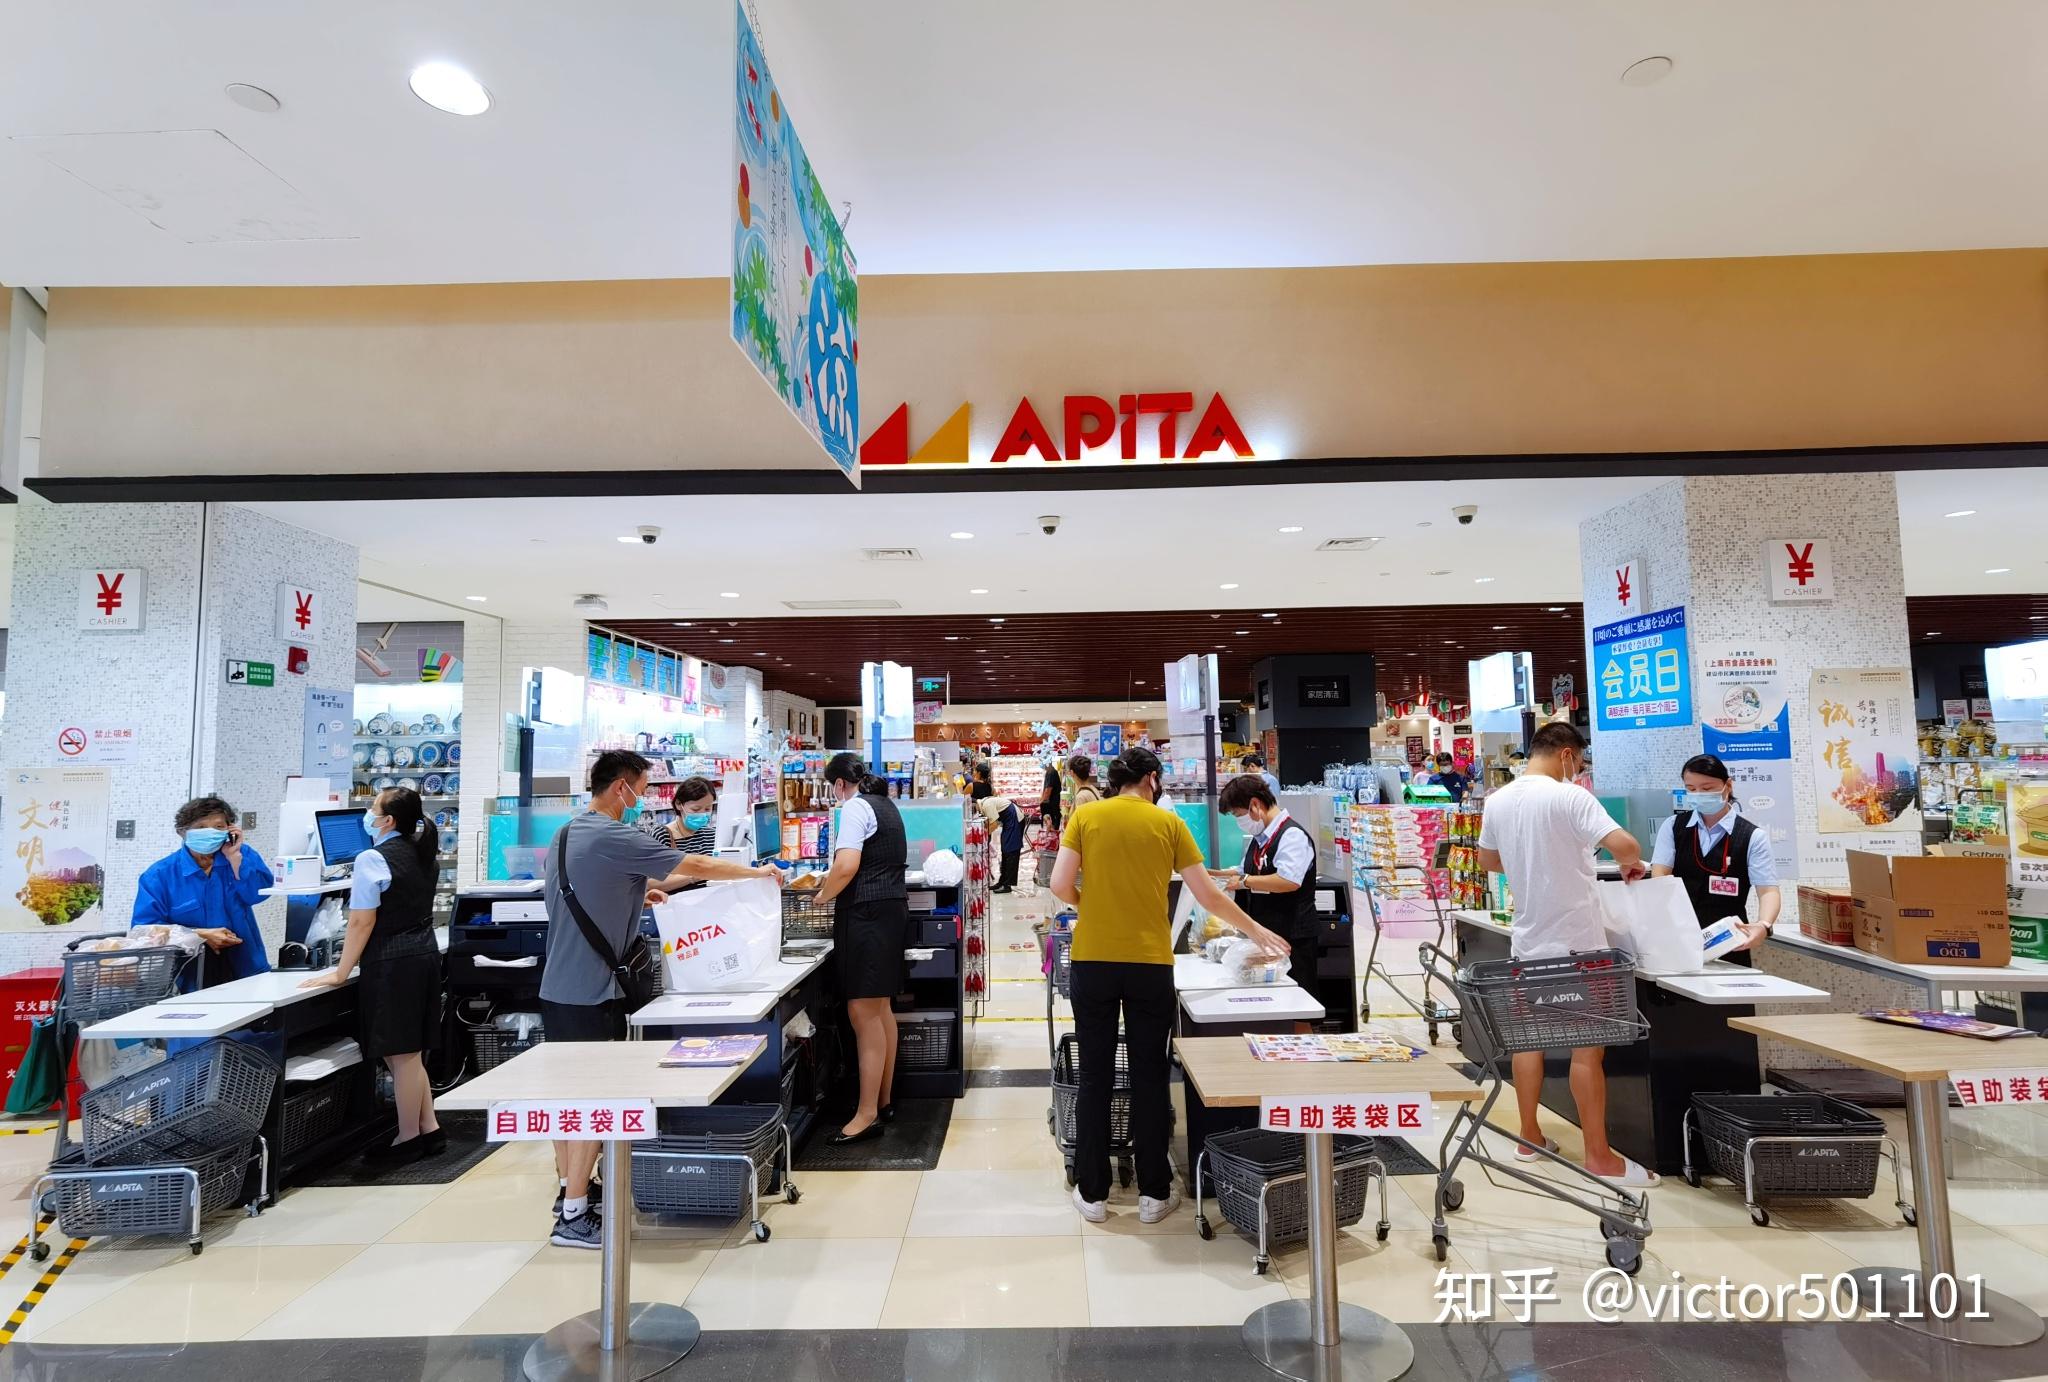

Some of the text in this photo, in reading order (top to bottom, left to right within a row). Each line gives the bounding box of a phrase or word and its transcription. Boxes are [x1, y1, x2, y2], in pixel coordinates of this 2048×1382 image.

[990, 391, 1255, 463] APITA
[1783, 587, 1823, 596] CASHIER
[89, 618, 128, 626] CASHIER
[1601, 648, 1680, 700] 会员日
[94, 729, 132, 738] 禁止吸烟
[675, 923, 727, 951] APITA
[1939, 947, 1968, 957] EDO
[1551, 992, 1584, 1003] APITA
[903, 1034, 922, 1042] APITA
[143, 1077, 172, 1093] APITA
[1268, 1103, 1423, 1129] 自助装袋区
[496, 1109, 645, 1135] 自助装袋区
[1813, 1148, 1840, 1157] APITA
[680, 1166, 706, 1174] APITA
[114, 1183, 144, 1192] APITA
